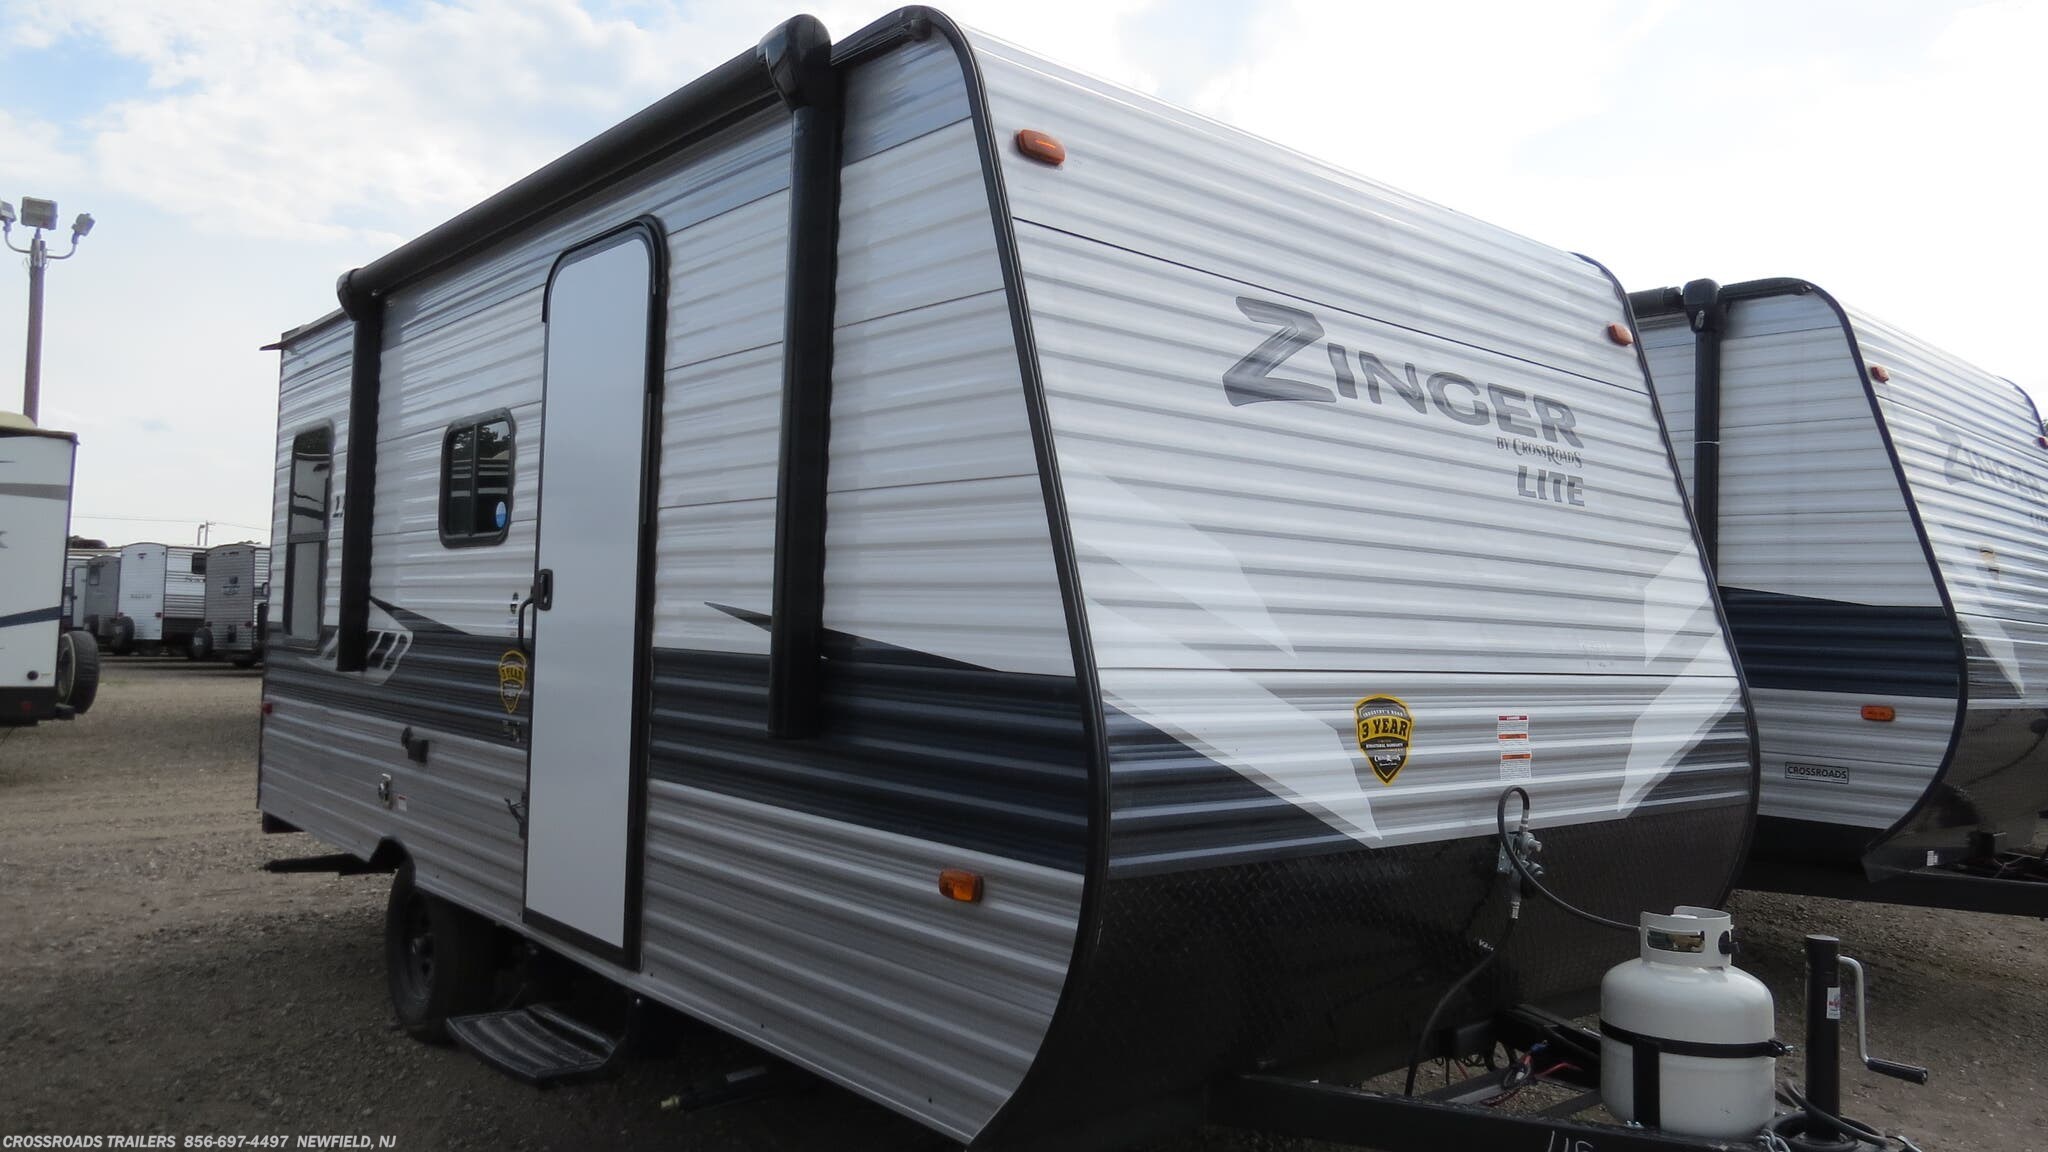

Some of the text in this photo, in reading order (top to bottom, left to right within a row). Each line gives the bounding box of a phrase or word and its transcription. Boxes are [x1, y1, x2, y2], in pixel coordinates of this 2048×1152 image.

[1222, 295, 1584, 449] ZINGER
[1496, 436, 1510, 450] BY
[1517, 465, 1585, 507] LITE
[1361, 718, 1408, 739] 3 YEAR
[1787, 766, 1847, 778] CROSSROADS
